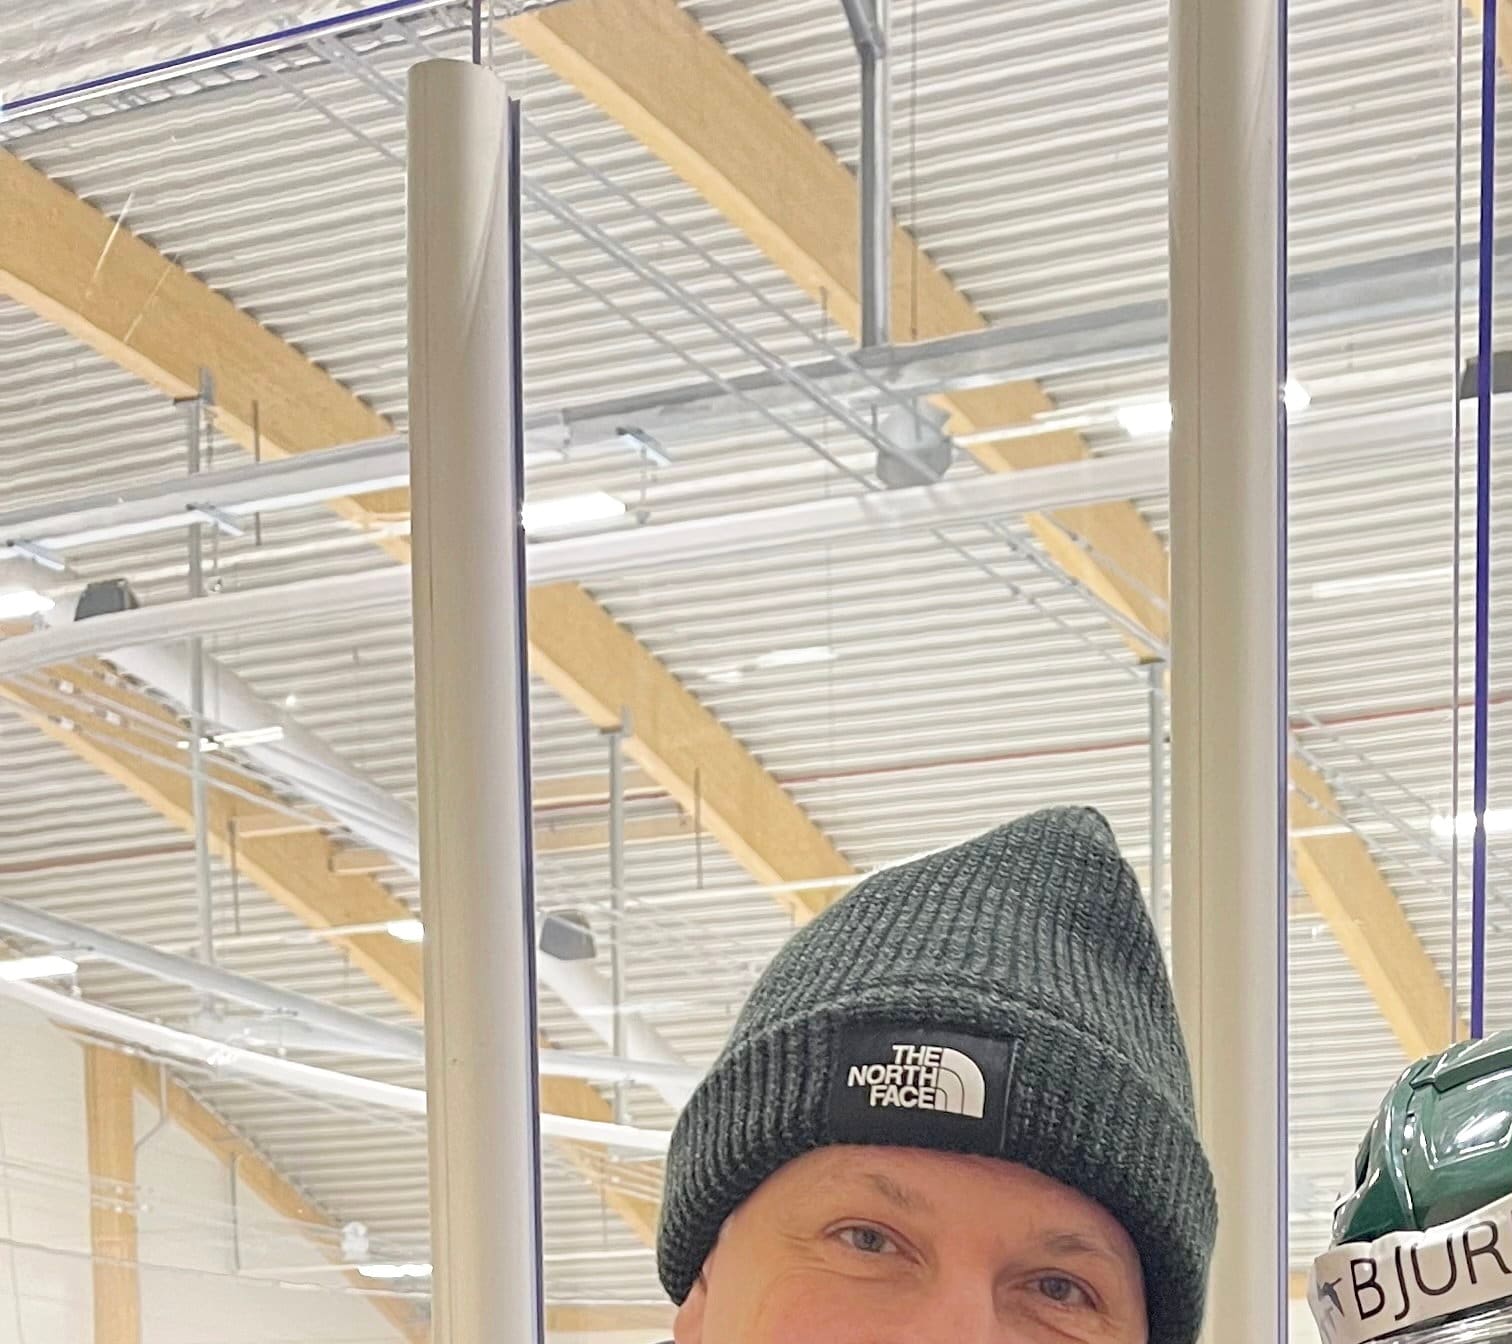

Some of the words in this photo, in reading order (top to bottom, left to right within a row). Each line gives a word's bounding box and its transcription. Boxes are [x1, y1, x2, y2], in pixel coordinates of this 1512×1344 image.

[893, 1044, 943, 1067] THE
[847, 1064, 938, 1087] NORTH
[870, 1084, 937, 1110] FACE
